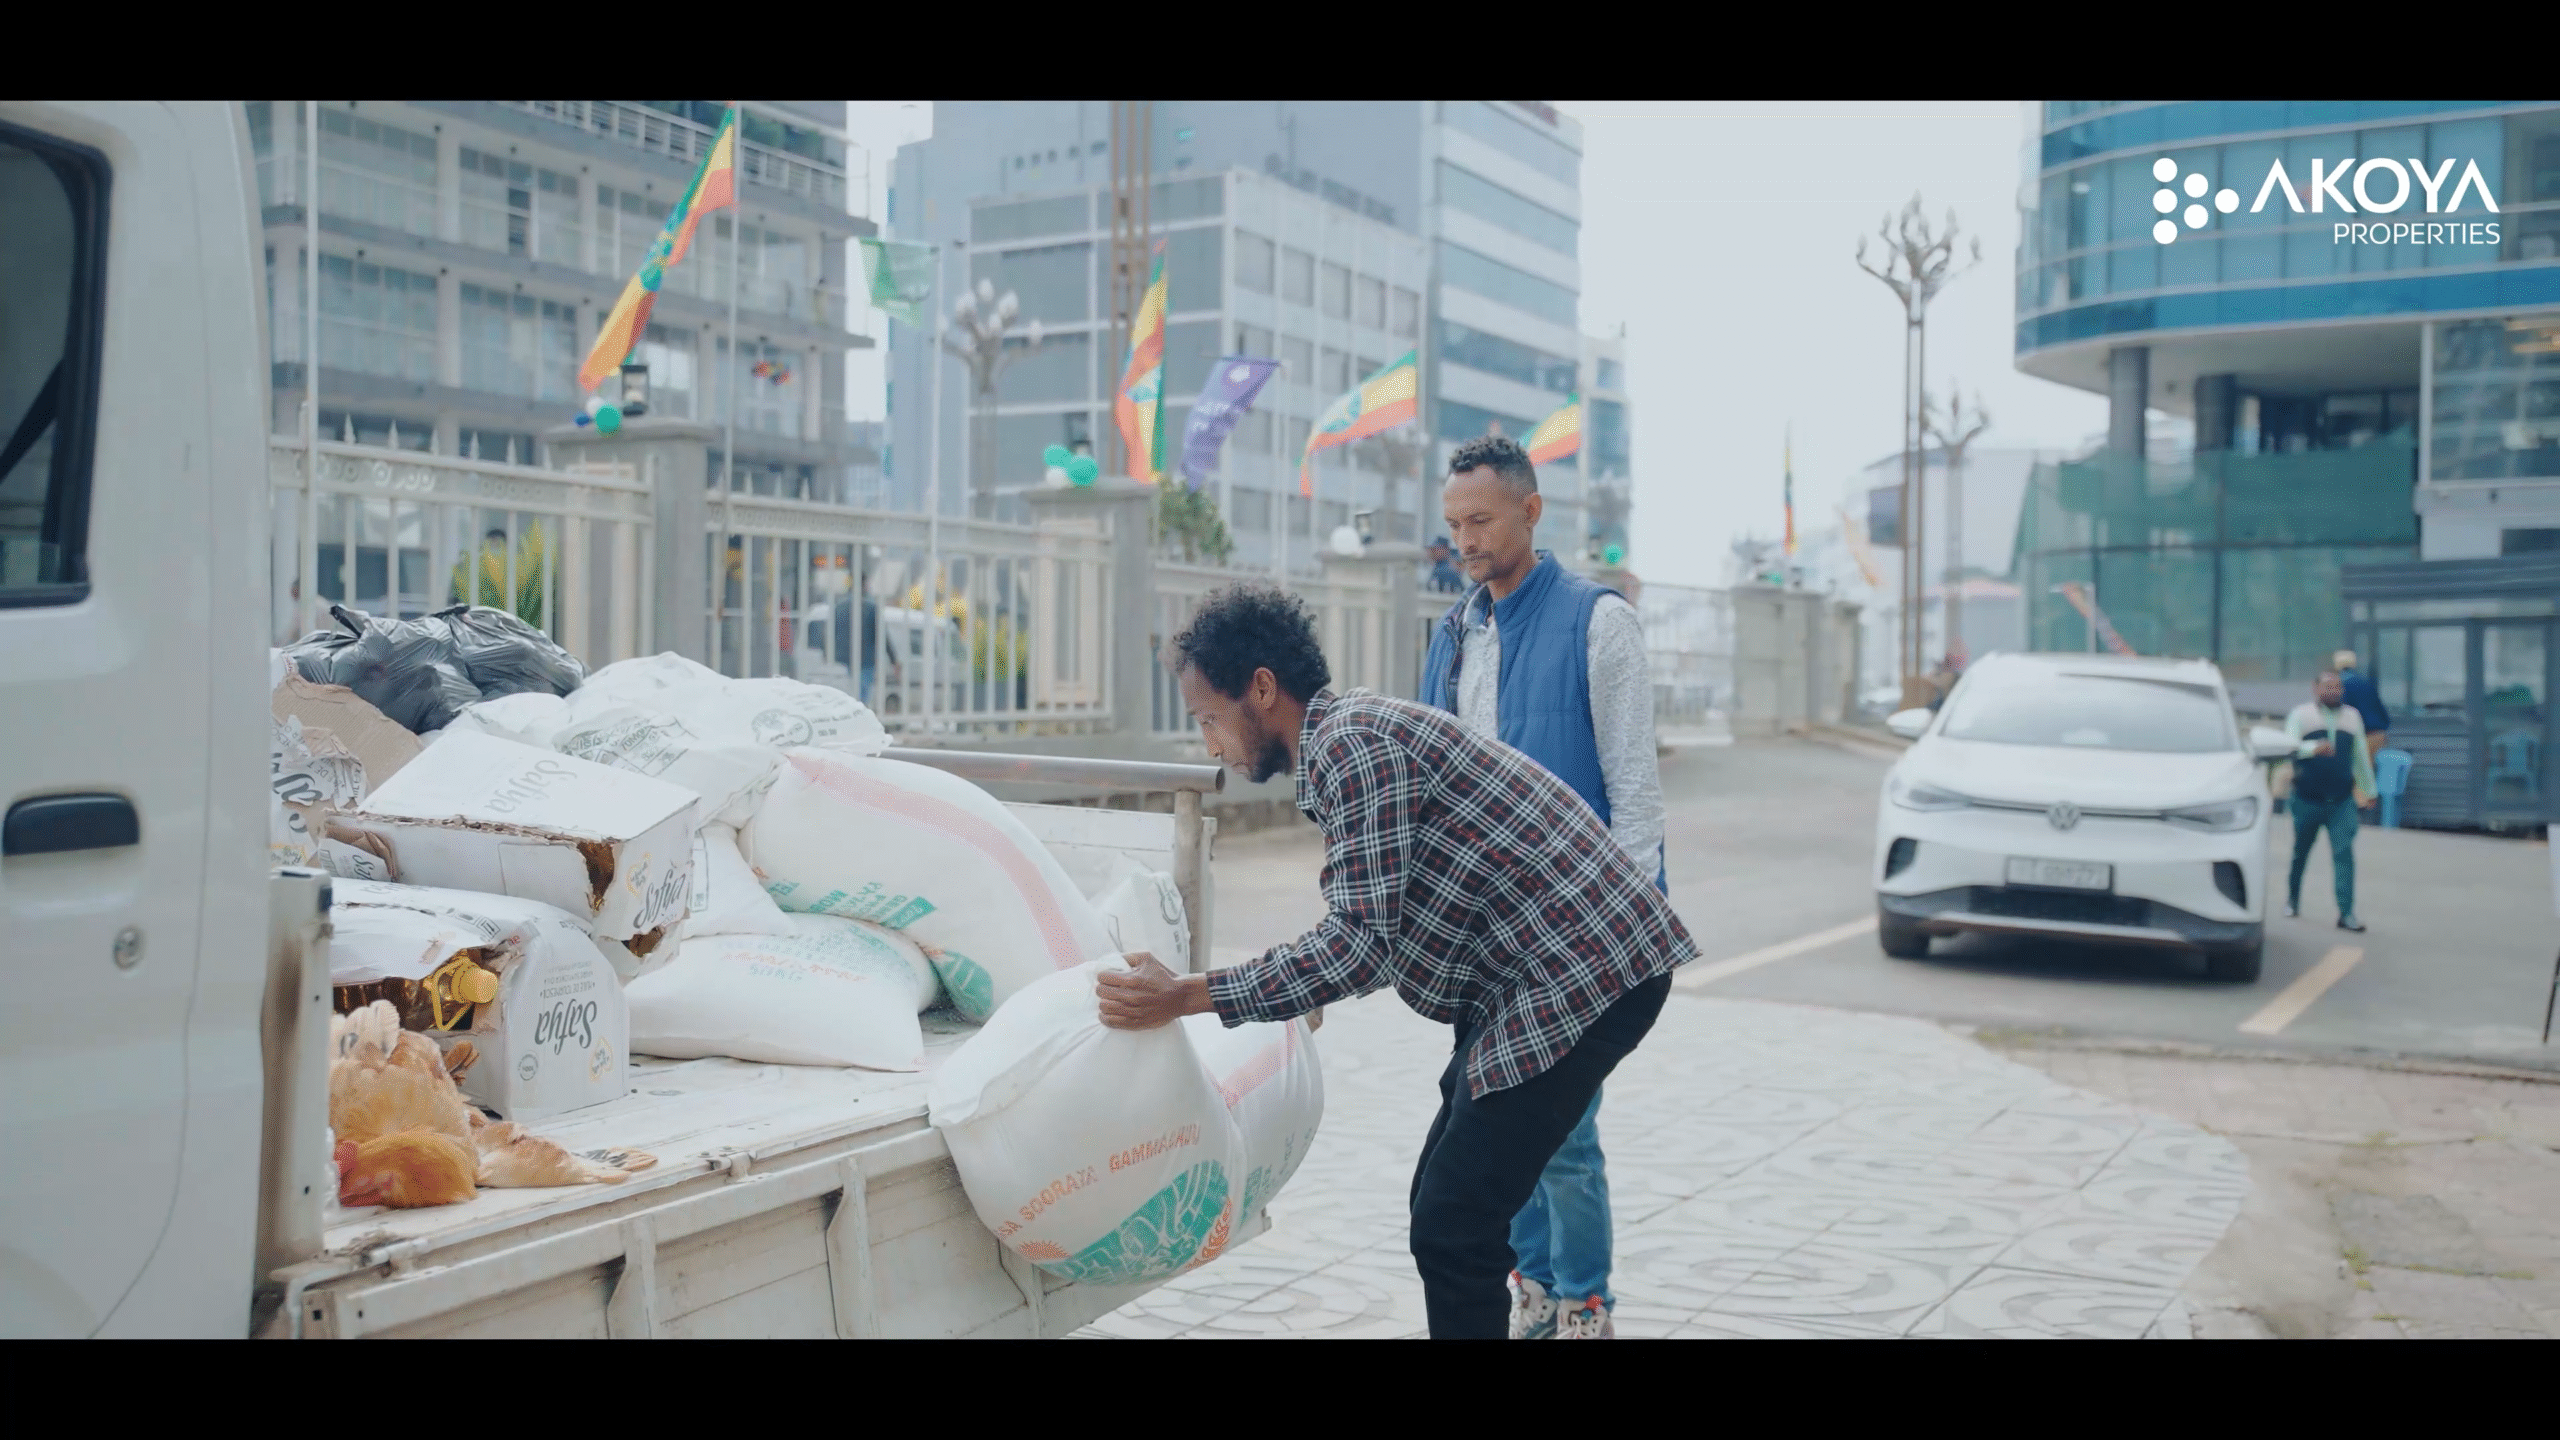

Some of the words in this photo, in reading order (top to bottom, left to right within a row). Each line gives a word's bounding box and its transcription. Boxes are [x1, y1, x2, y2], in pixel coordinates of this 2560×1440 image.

[484, 759, 578, 814] Safya
[633, 868, 687, 930] Safya
[534, 998, 598, 1055] Safya
